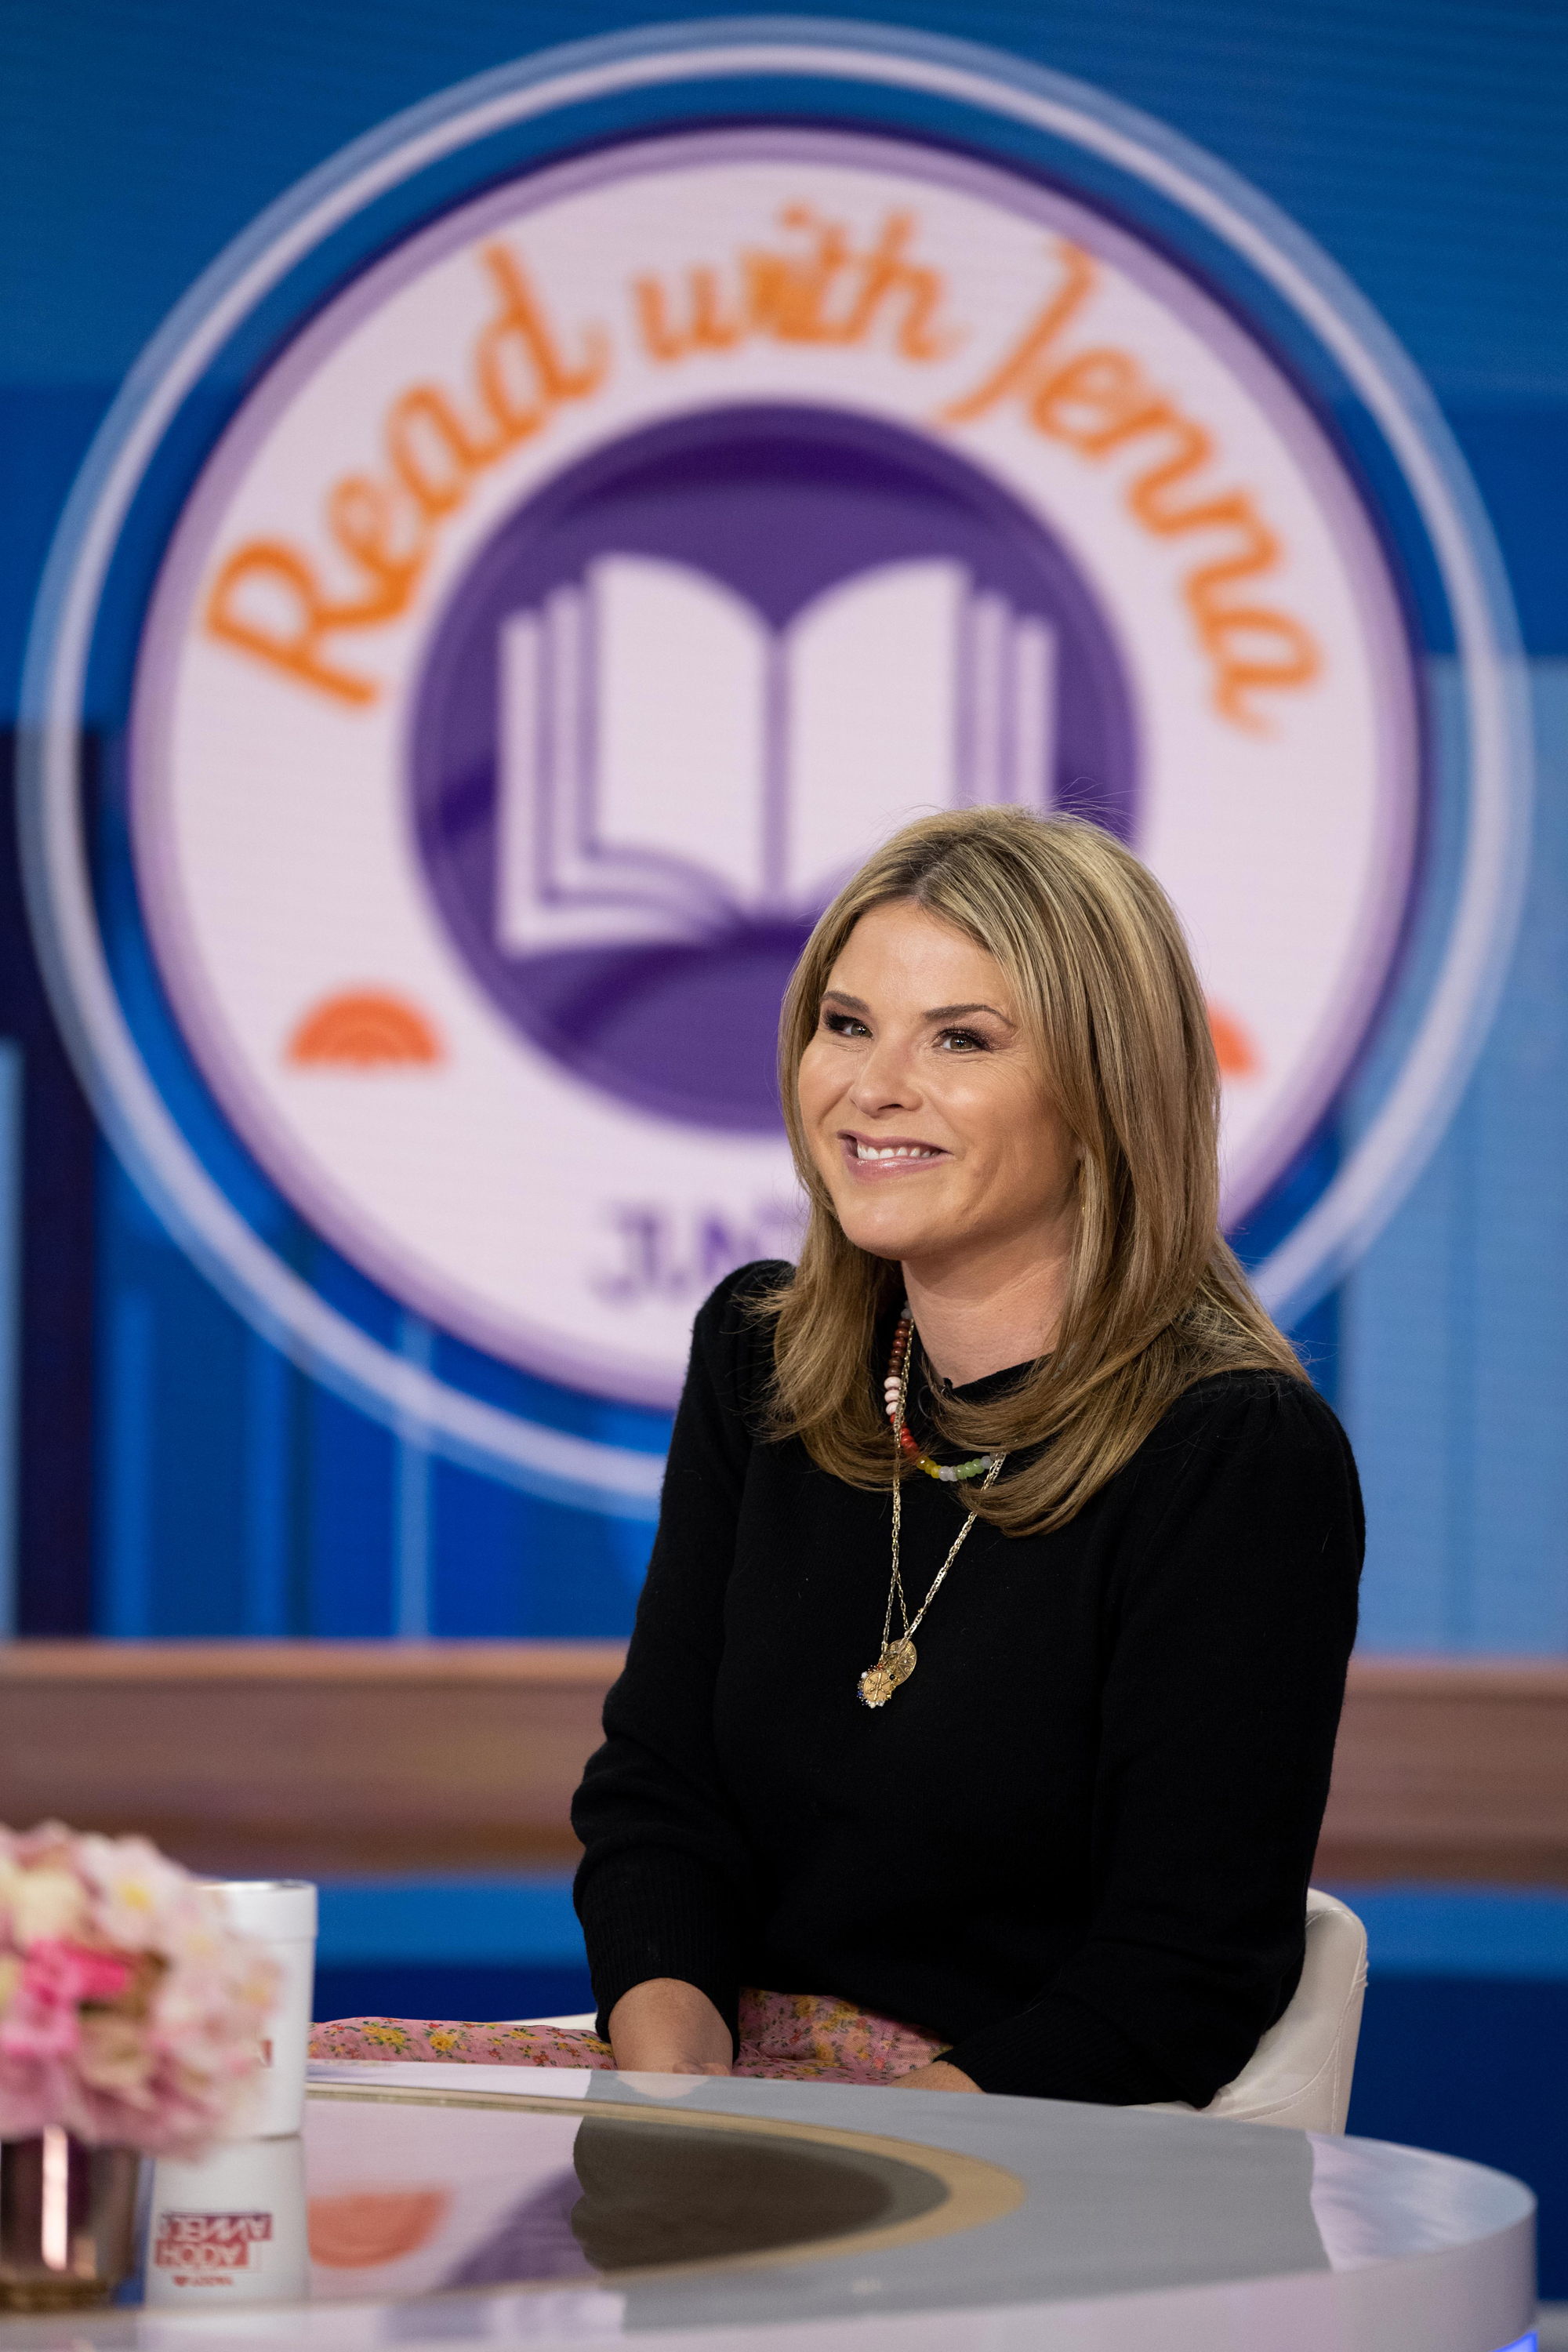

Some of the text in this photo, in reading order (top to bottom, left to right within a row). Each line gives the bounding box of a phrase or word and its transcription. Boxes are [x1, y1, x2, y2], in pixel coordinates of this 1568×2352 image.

[205, 201, 1321, 741] Read with Jenna
